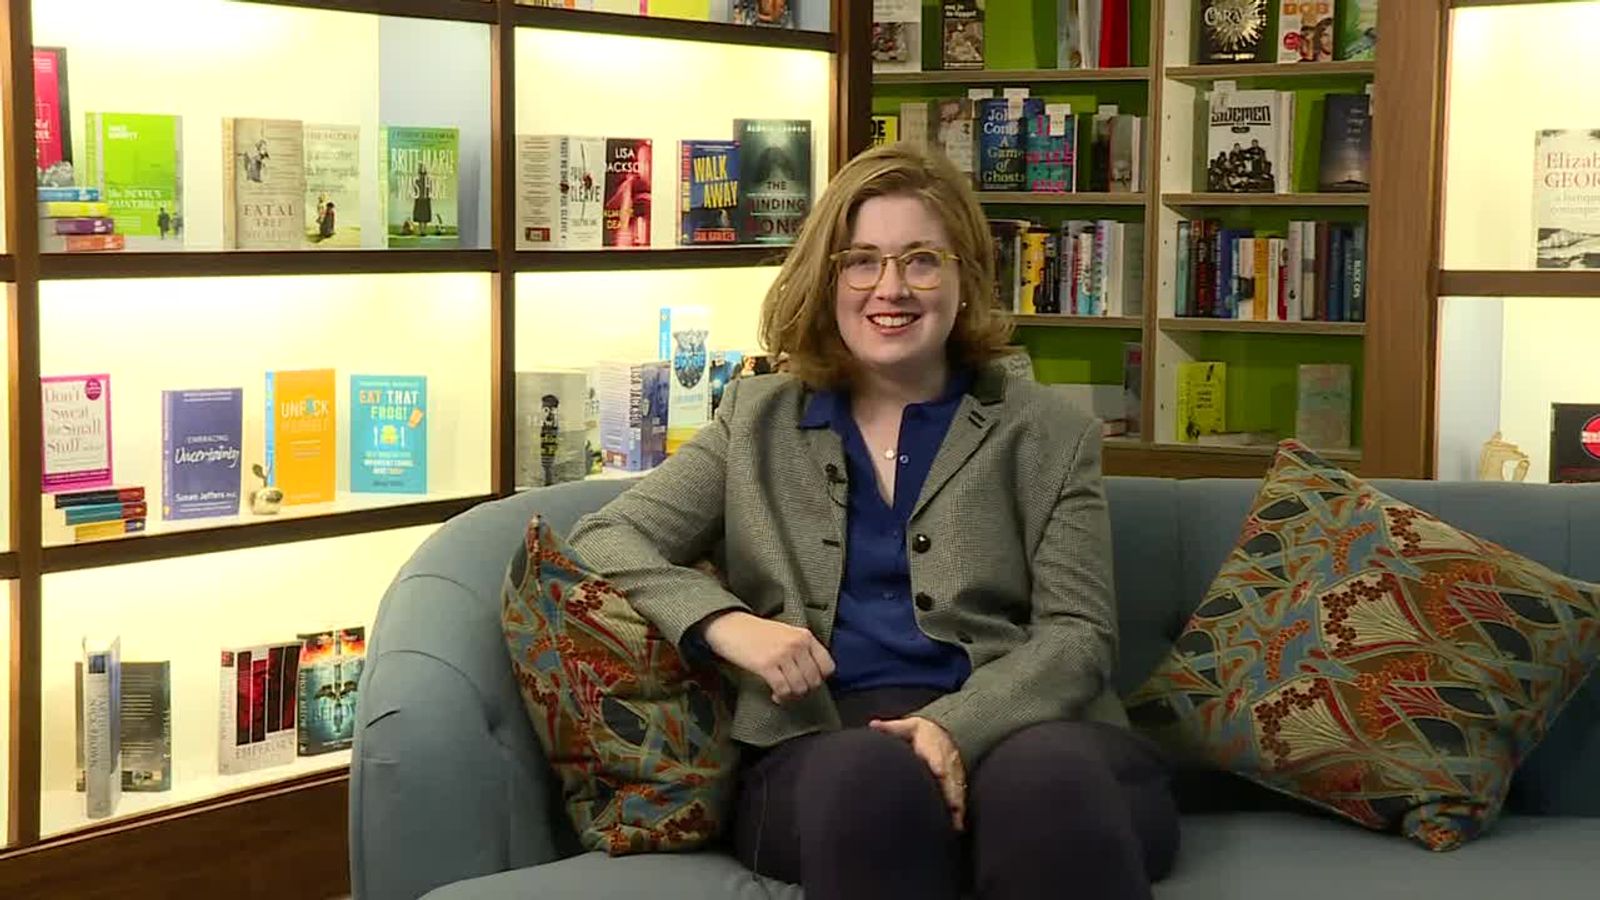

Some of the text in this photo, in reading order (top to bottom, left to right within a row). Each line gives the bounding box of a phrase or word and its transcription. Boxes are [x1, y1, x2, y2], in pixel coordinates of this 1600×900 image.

[614, 147, 635, 159] LISA
[693, 154, 728, 183] WALK
[995, 159, 1009, 172] of
[767, 180, 788, 191] THE
[703, 180, 738, 209] AWAY
[243, 202, 295, 217] FATAL
[1353, 259, 1362, 298] BLACK OPS
[630, 366, 642, 385] LISA
[359, 389, 419, 405] EAT THAT
[51, 406, 89, 420] Sweat
[370, 405, 408, 421] FROG!
[630, 387, 642, 428] JACKSON
[63, 418, 102, 436] Small
[174, 445, 240, 469] Uncertainty
